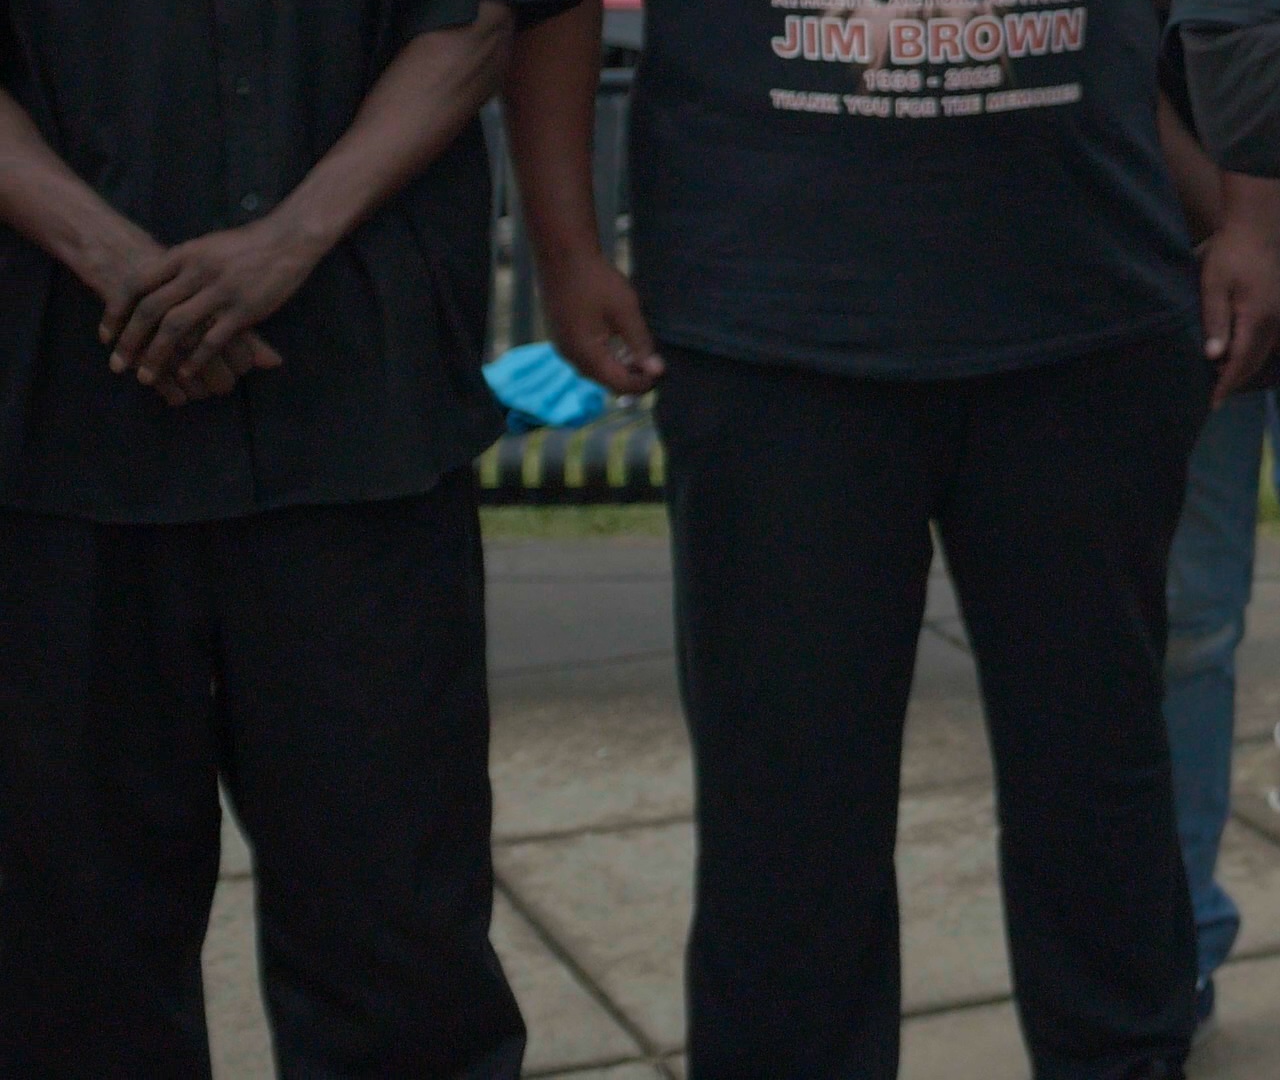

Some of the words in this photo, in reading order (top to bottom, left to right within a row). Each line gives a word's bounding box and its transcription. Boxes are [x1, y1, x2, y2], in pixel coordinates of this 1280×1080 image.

[770, 14, 870, 64] JIM
[890, 10, 1086, 64] BROWN
[842, 92, 892, 118] YOU
[894, 95, 939, 119] FOR
